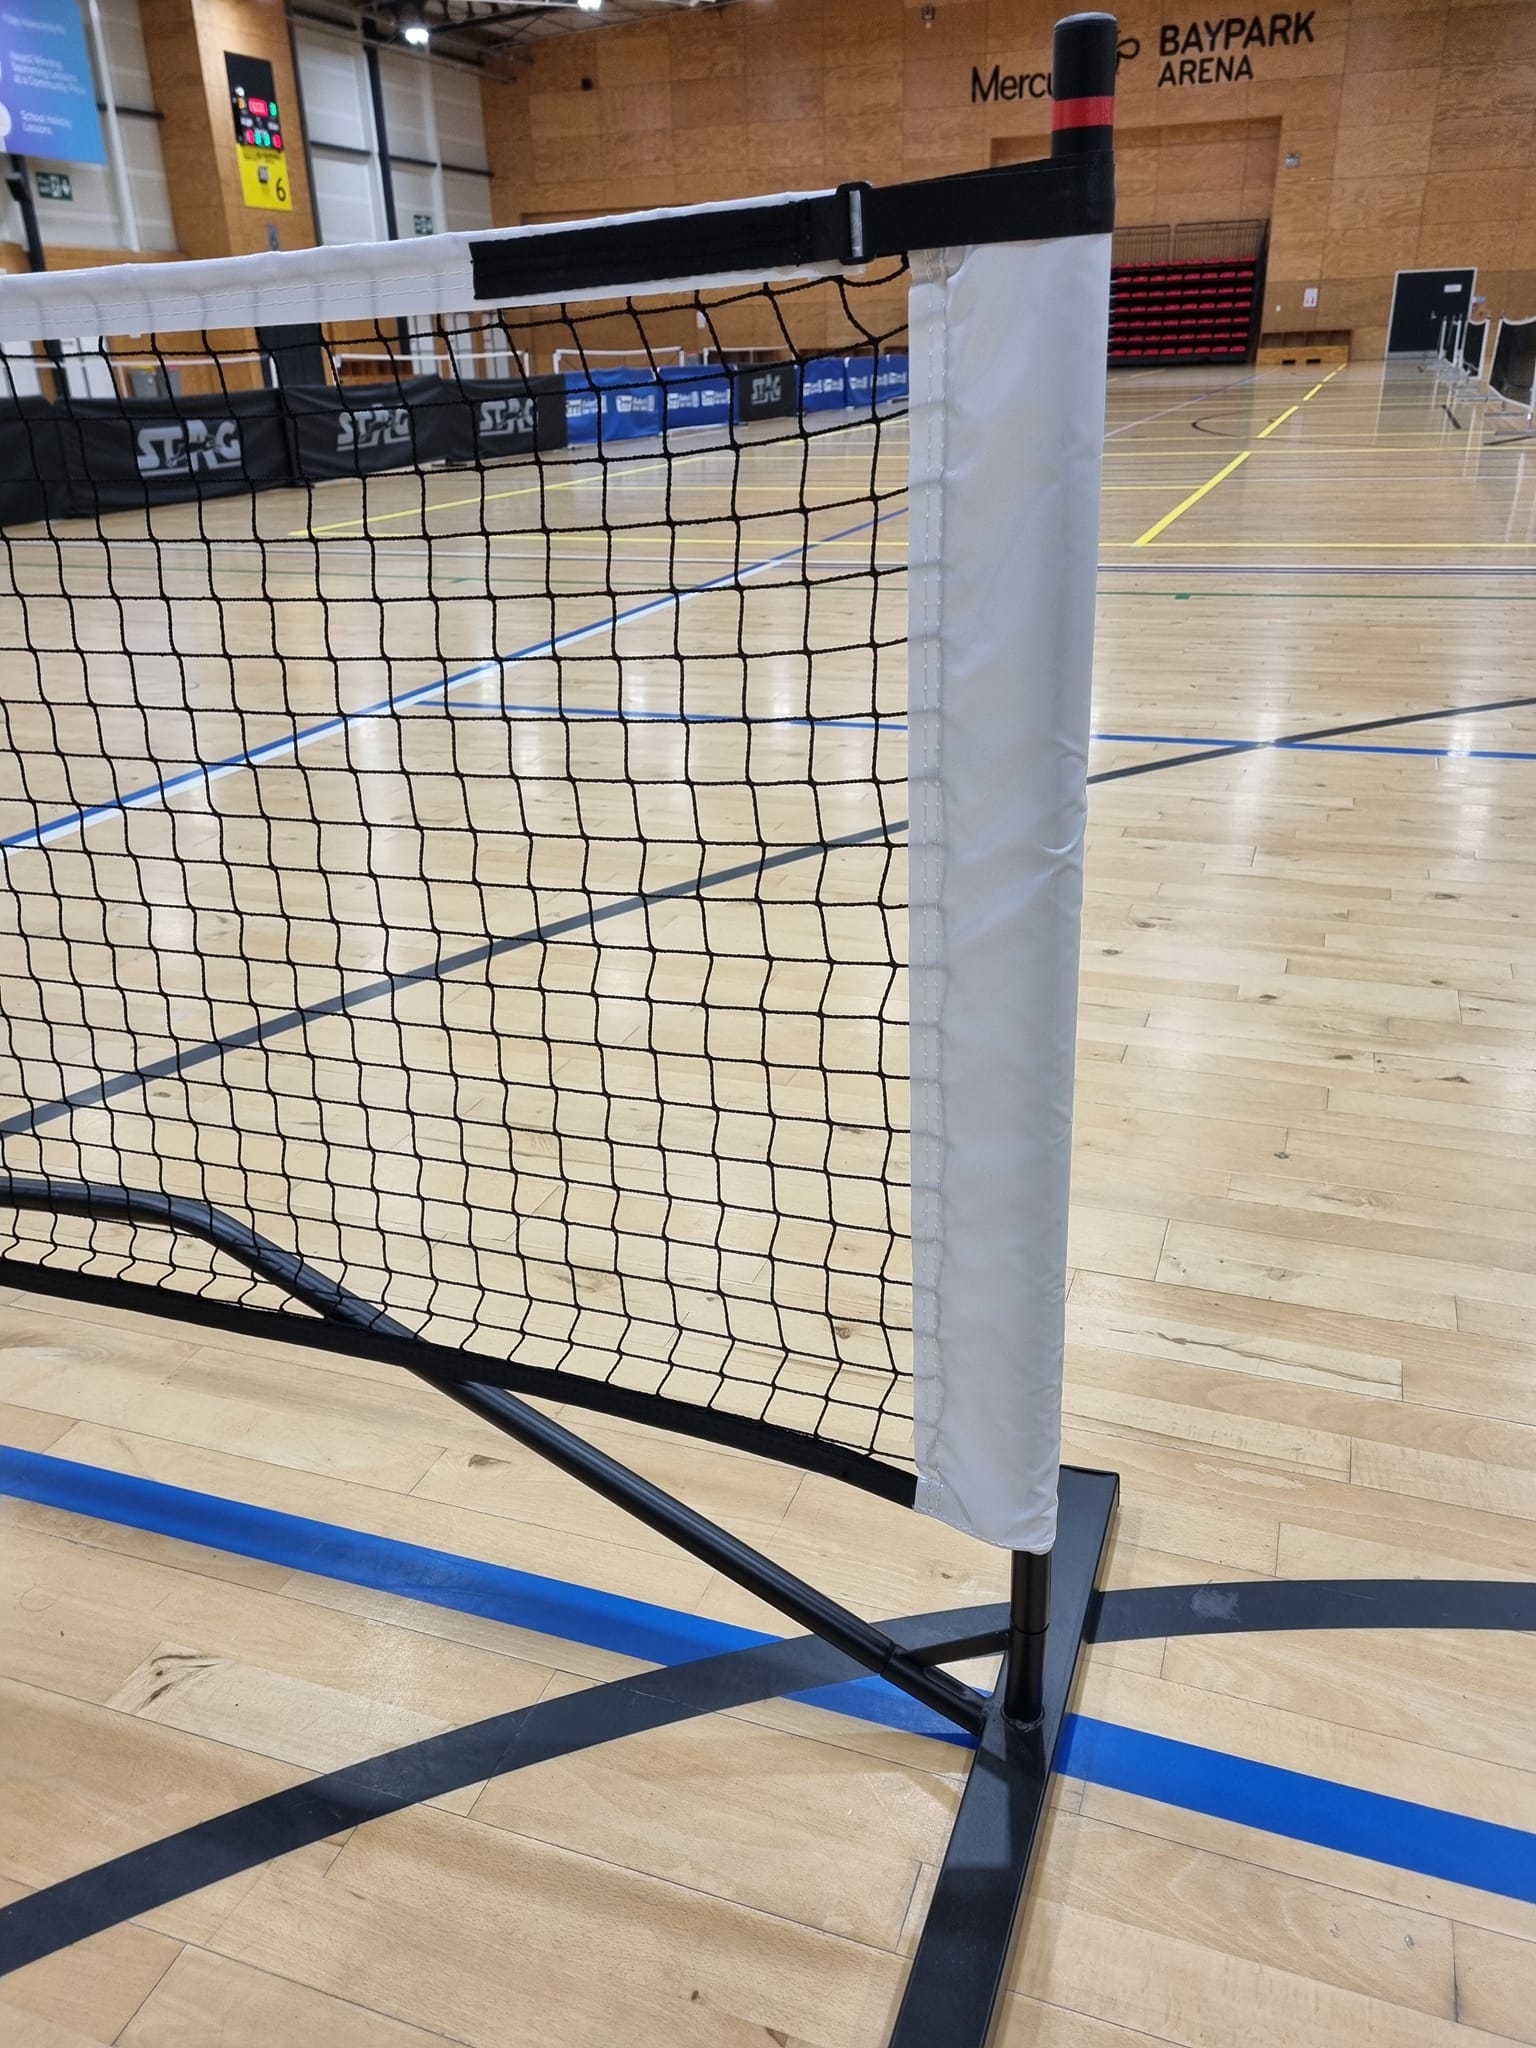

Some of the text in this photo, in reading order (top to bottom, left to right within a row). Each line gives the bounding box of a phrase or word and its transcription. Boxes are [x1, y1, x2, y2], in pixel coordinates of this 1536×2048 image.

[1159, 10, 1315, 57] BAYPARK
[1157, 54, 1254, 88] ARENA
[276, 177, 287, 202] 6
[137, 419, 241, 478] STAG
[336, 403, 411, 452] STAG
